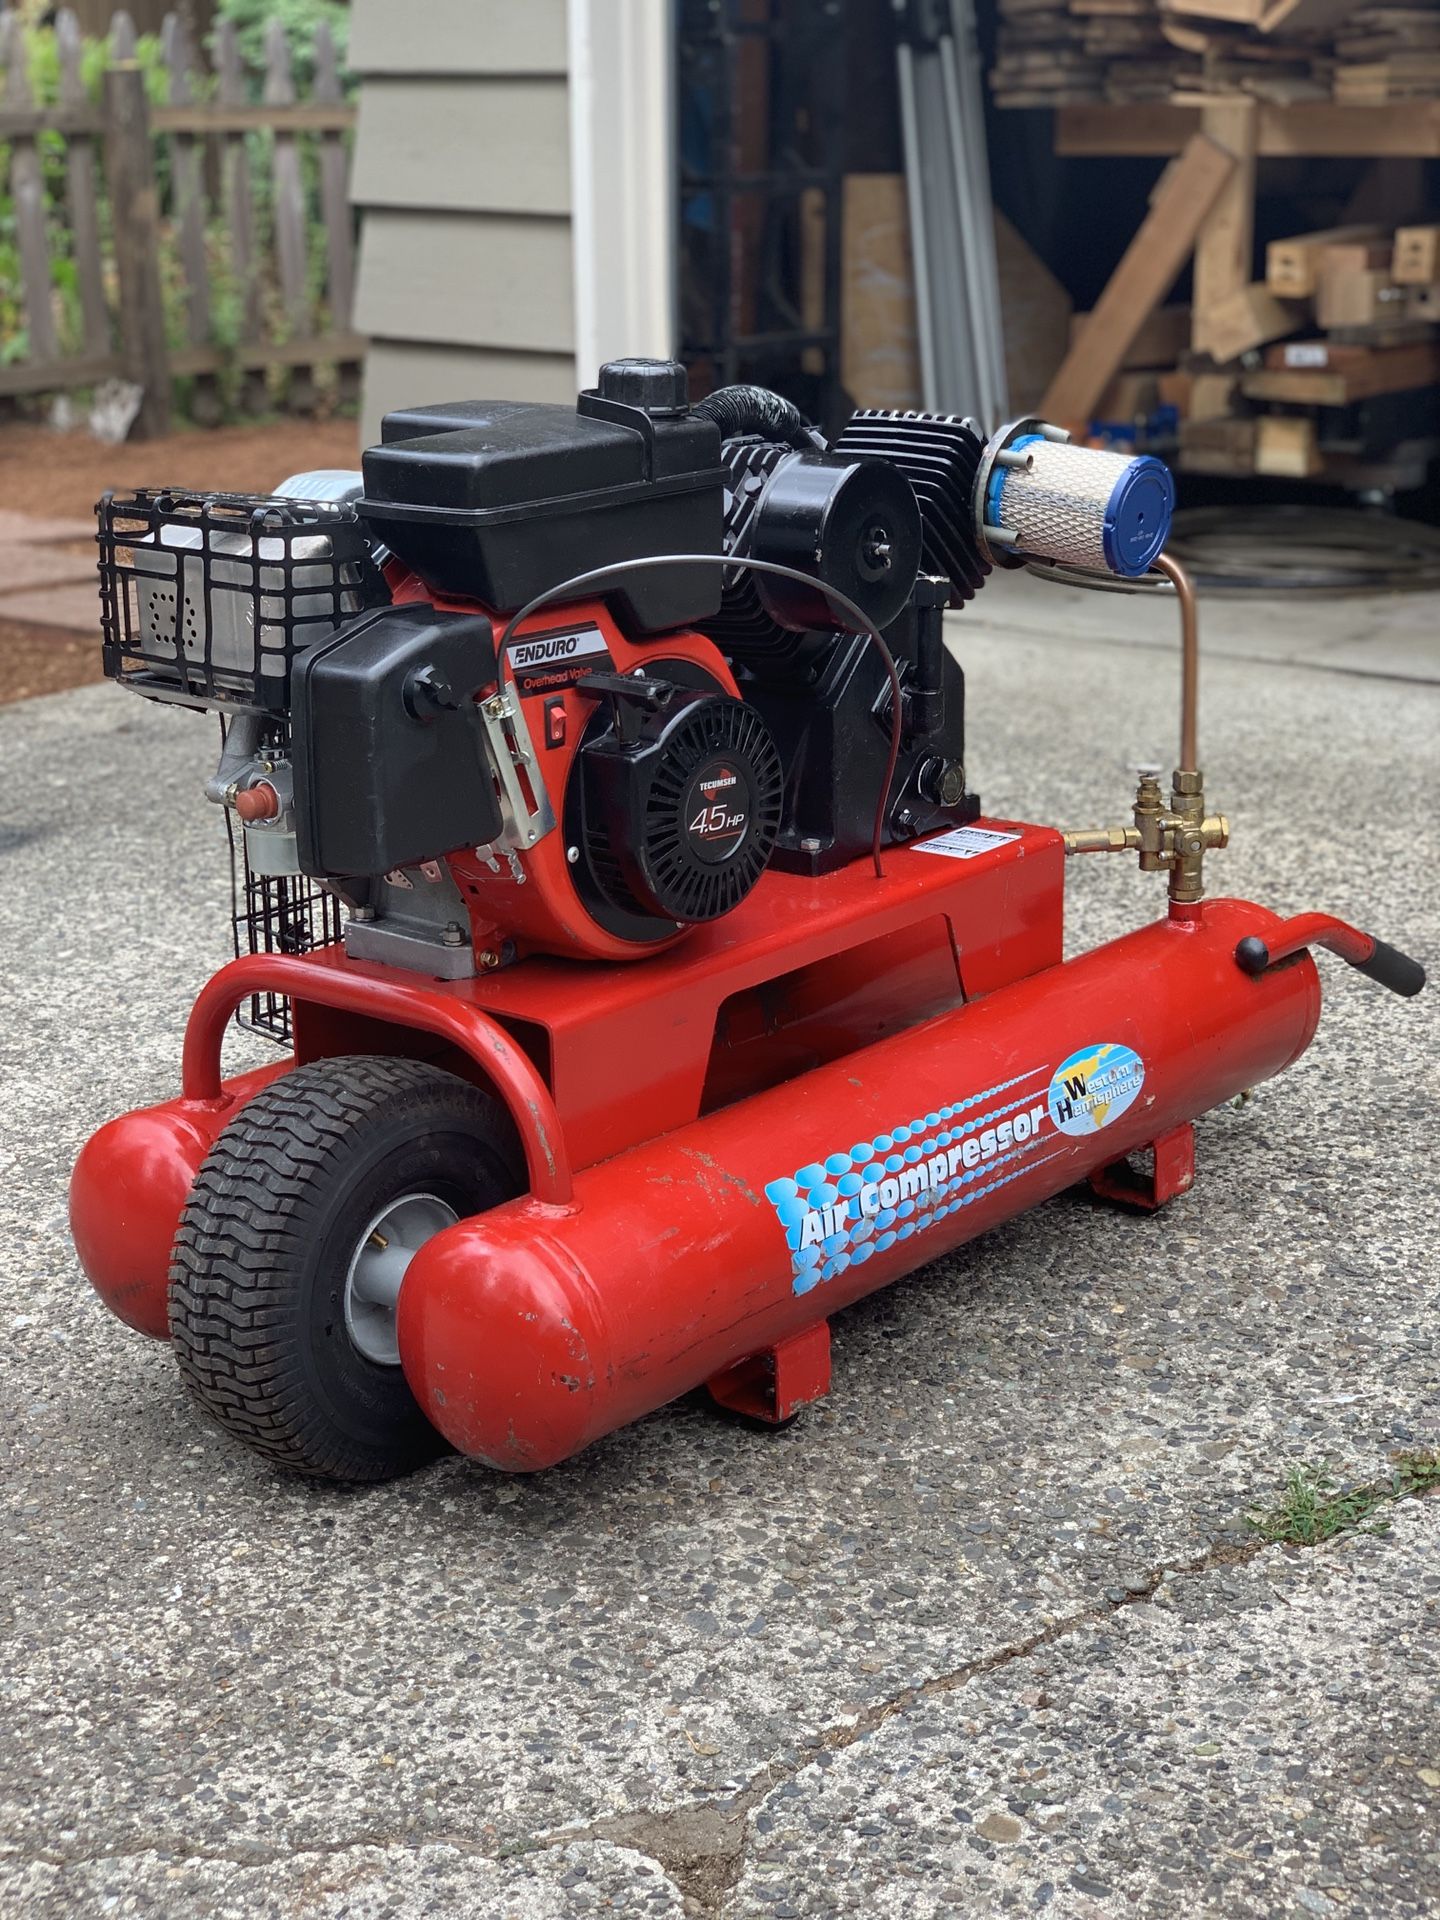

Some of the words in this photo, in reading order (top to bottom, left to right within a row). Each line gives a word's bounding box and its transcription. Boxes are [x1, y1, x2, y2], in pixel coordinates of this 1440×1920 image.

[514, 637, 578, 665] ENDURO
[523, 669, 568, 690] Overhead
[699, 776, 737, 791] TECUMSEH
[689, 804, 728, 834] 4.5
[726, 813, 745, 827] HP
[1056, 1076, 1141, 1124] Hemisphere
[799, 1201, 849, 1252] Air
[860, 1104, 1045, 1218] Compressor
